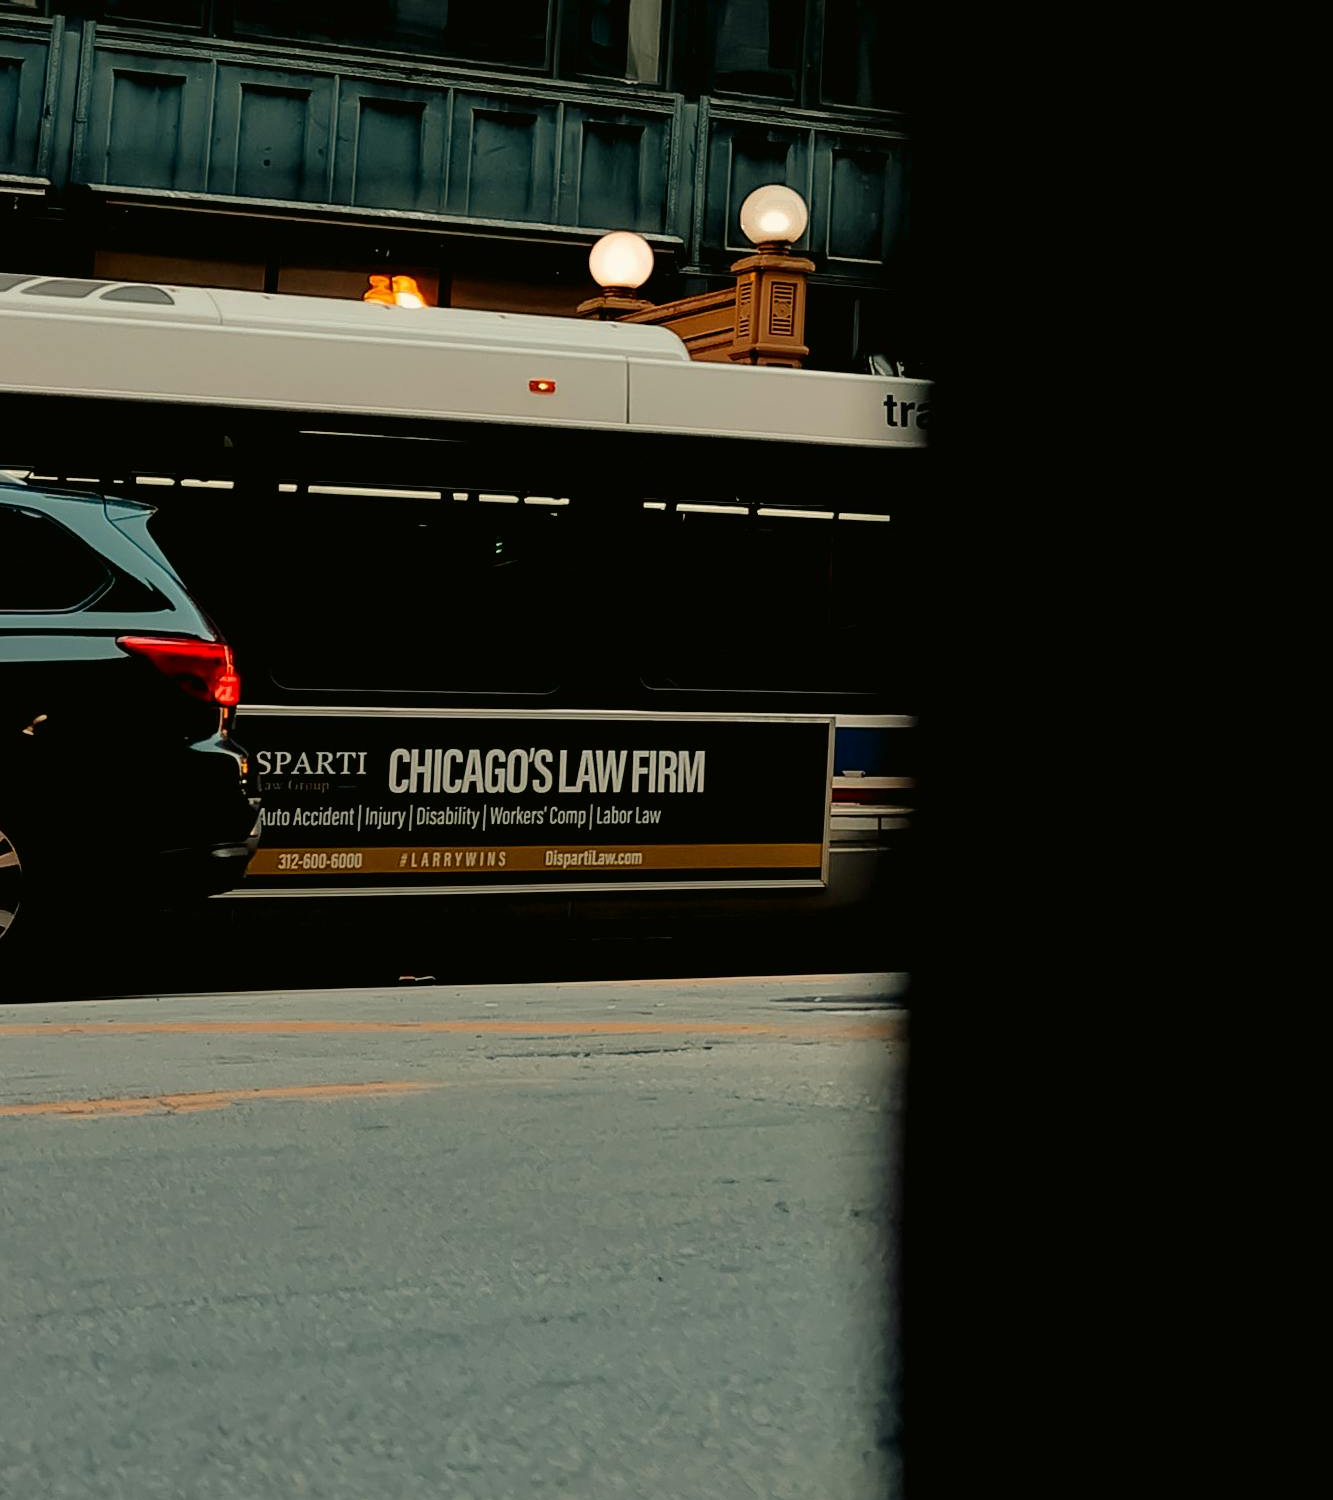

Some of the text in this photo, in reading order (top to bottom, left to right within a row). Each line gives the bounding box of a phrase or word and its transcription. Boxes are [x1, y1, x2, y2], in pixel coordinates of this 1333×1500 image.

[256, 750, 368, 776] SPARTI
[388, 747, 706, 794] CHICAGO'S LAW FIRM
[258, 806, 662, 830] Auto Accident Injury Disability Workers' Comp Labor Law
[277, 852, 363, 870] 312-600-6000
[544, 850, 643, 869] DispartiLaw.com
